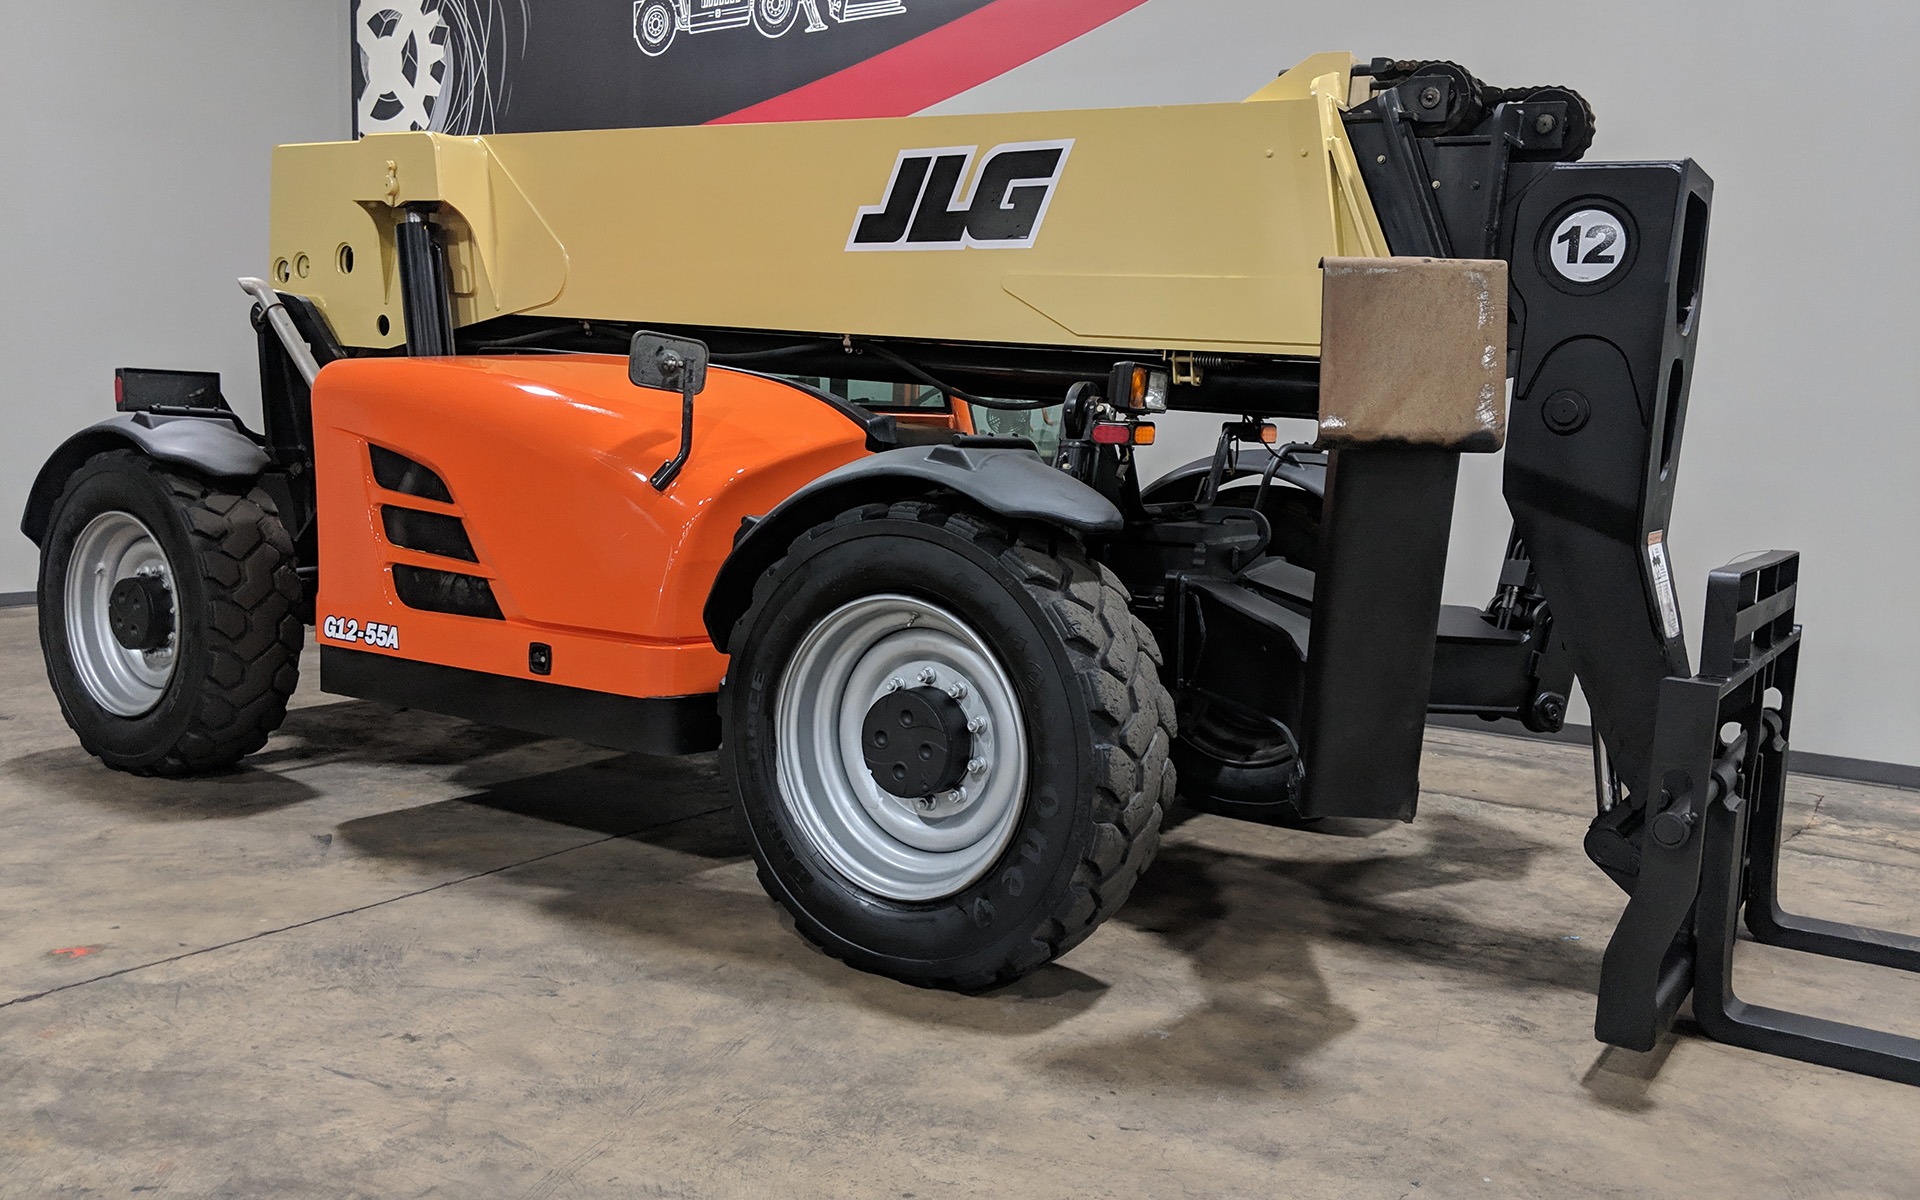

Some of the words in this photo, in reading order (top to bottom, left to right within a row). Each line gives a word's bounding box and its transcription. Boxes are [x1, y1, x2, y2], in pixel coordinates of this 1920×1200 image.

[852, 146, 1066, 245] JLG
[1557, 224, 1617, 264] 12
[323, 614, 400, 650] G12-55A
